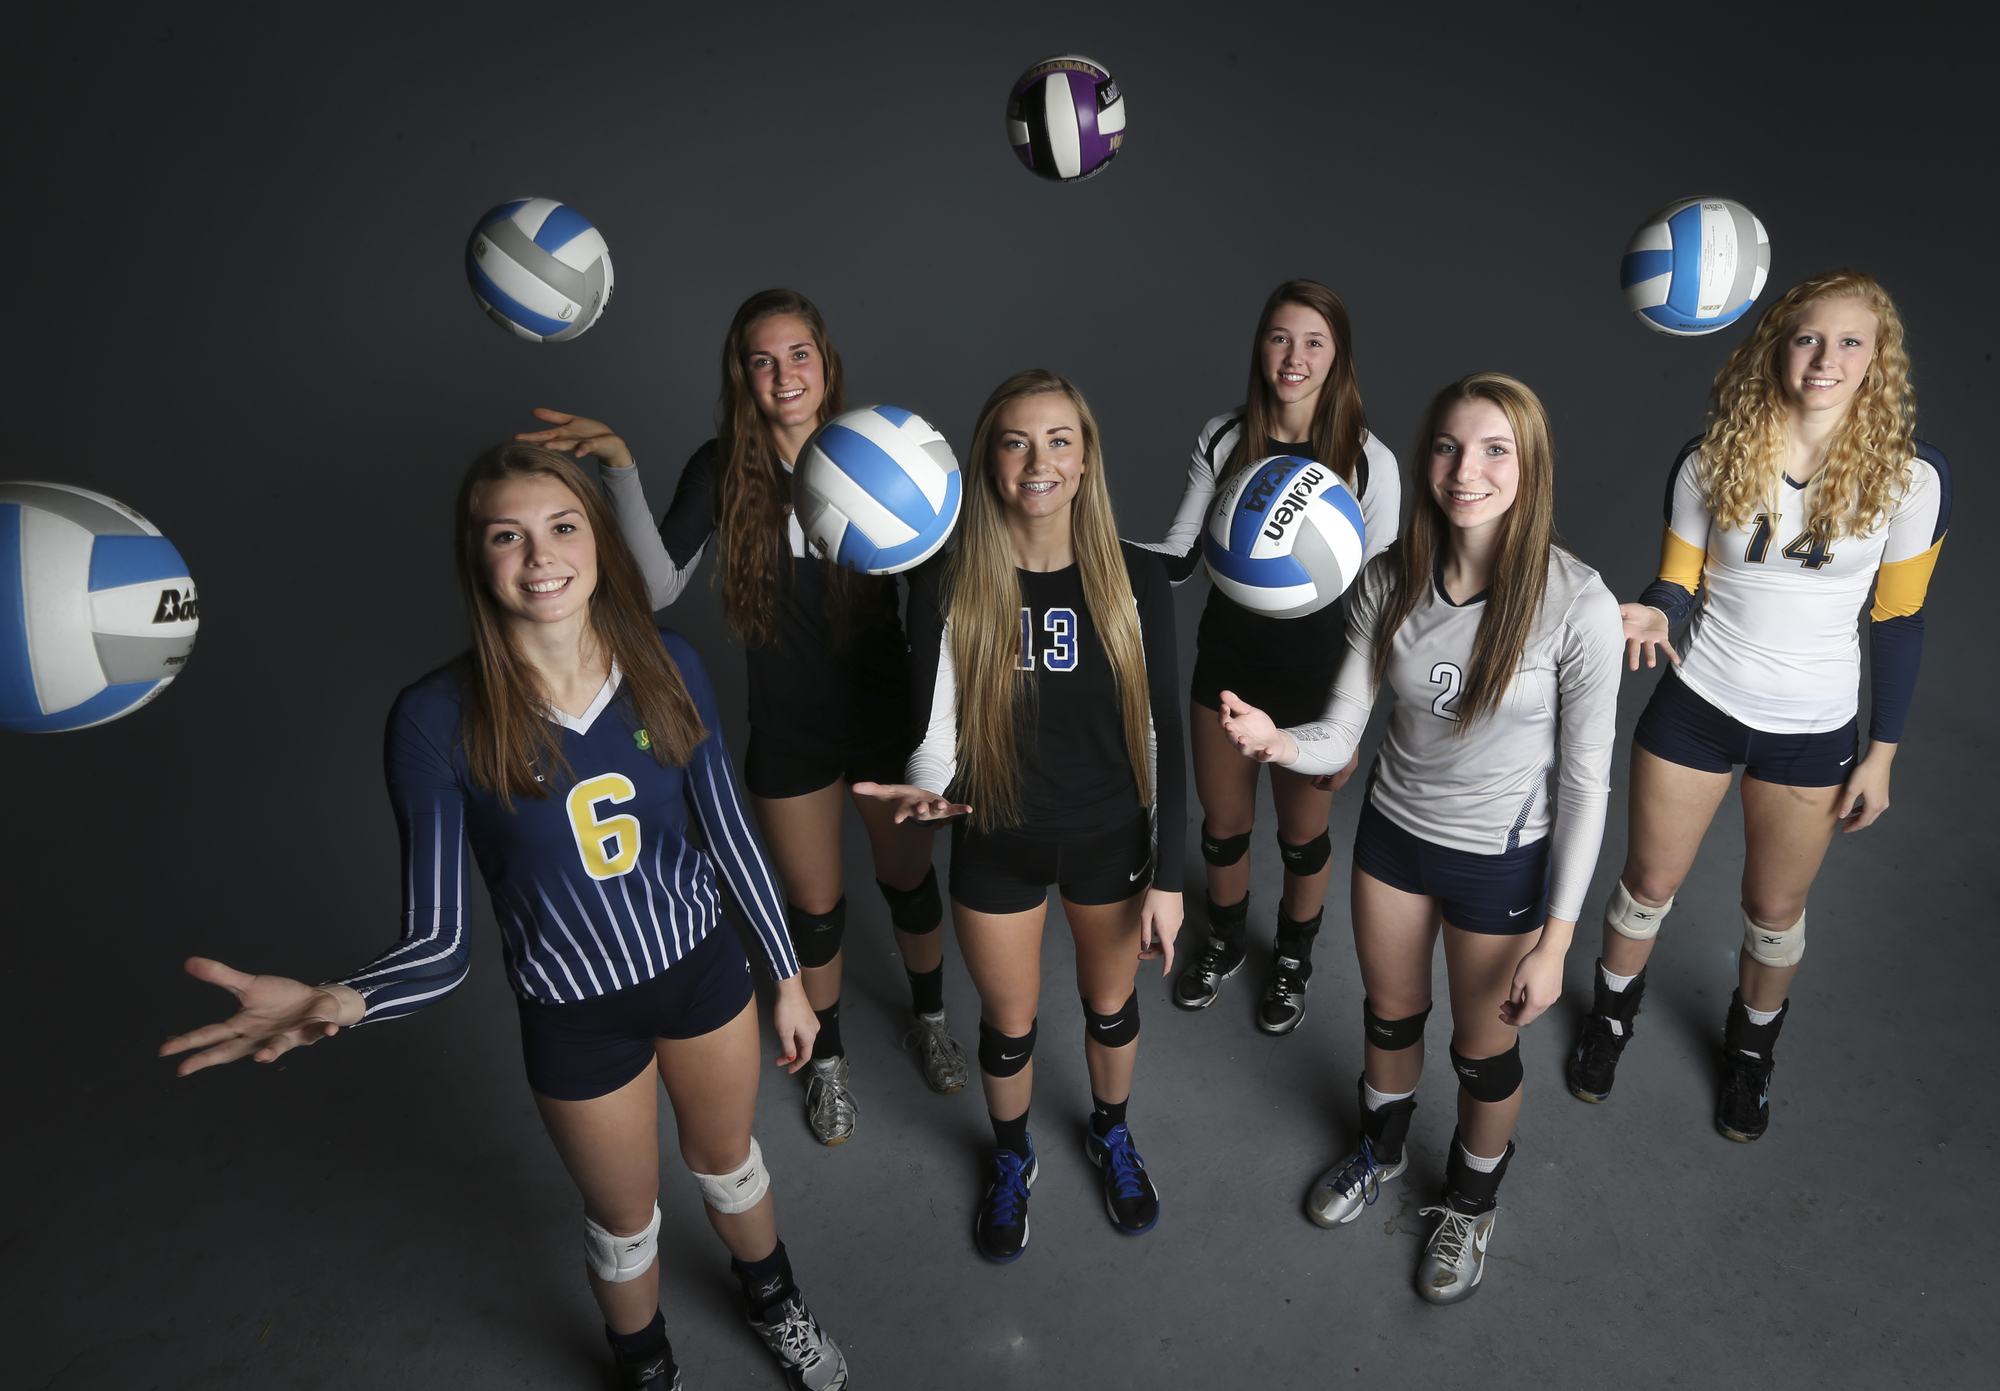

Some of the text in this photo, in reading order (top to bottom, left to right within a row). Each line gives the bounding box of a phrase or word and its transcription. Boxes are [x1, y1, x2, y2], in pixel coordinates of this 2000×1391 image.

[1021, 61, 1099, 84] VOLLEYBALL
[1243, 459, 1299, 513] NCAA
[1263, 467, 1325, 541] molten
[1744, 512, 1835, 570] 14
[1014, 607, 1079, 672] 13
[1429, 661, 1463, 723] 2
[565, 772, 641, 881] 6
